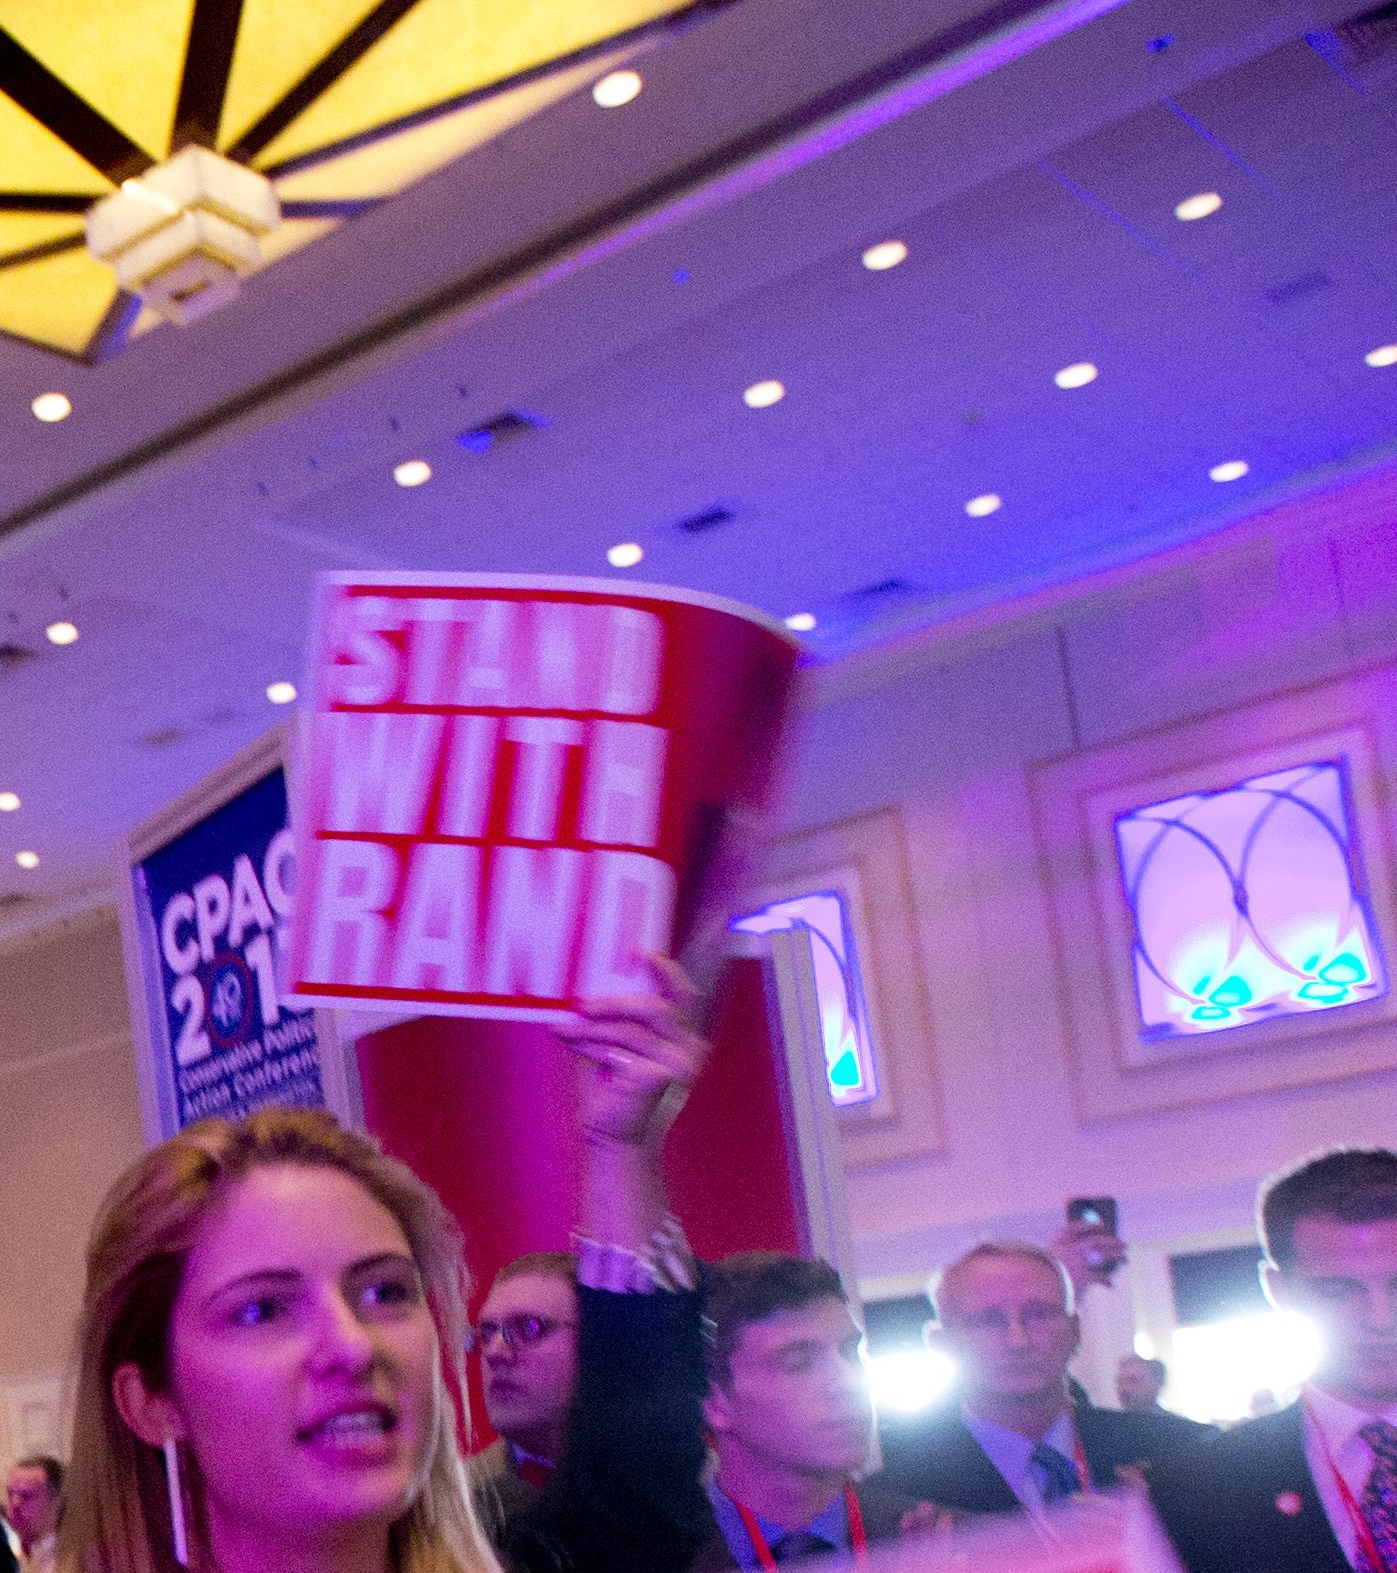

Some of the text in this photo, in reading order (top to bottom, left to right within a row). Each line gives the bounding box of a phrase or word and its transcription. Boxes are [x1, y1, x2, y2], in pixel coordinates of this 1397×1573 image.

[325, 594, 667, 717] STAND
[311, 711, 672, 850] WITH
[303, 839, 679, 1003] RAND
[171, 928, 312, 1066] 201
